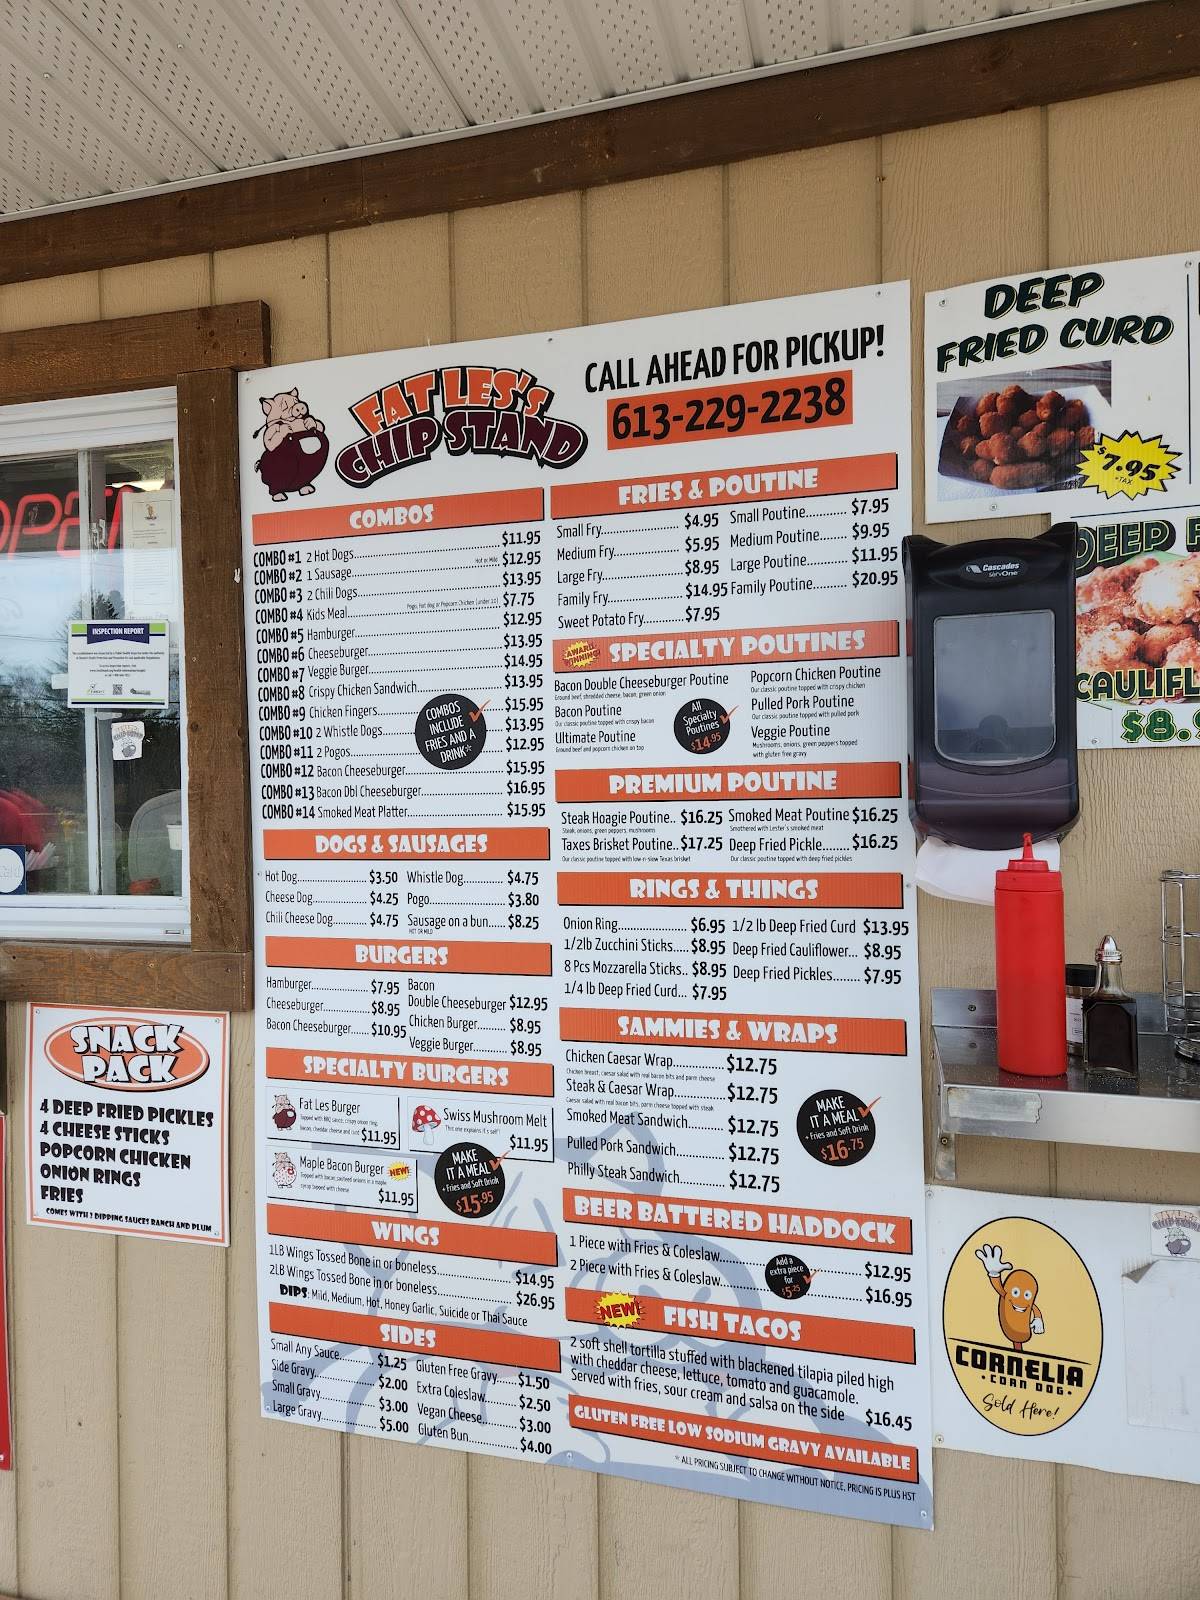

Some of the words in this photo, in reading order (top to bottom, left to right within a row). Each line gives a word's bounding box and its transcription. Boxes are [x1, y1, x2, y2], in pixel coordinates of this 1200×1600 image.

[984, 272, 1104, 319] DEEP
[937, 323, 1048, 372] FRIED
[1060, 314, 1174, 348] CURD
[585, 360, 640, 393] CALL
[647, 346, 726, 388] AHEAD
[732, 341, 778, 373] FOR
[785, 325, 884, 367] PICKUP!
[349, 370, 437, 436] FAT
[612, 377, 848, 440] 613-229-2238
[336, 419, 443, 489] CHIP
[440, 414, 588, 469] STAND
[1098, 446, 1160, 480] $7.95
[619, 481, 683, 506] FRIES
[688, 479, 703, 500] &
[709, 468, 818, 498] POUTINE
[349, 504, 435, 529] COMBOS
[557, 525, 584, 539] Small
[685, 513, 719, 529] $4.95
[315, 550, 329, 562] Hot
[502, 531, 541, 547] $11.95
[983, 563, 1019, 572] Cascades
[731, 582, 766, 598] Family
[852, 571, 898, 588] $20.95
[610, 637, 734, 663] SPECIALTY
[742, 630, 865, 657] POUTINES
[309, 685, 335, 699] Crispy
[338, 684, 371, 697] Chicken
[505, 674, 543, 689] $13.95
[751, 670, 792, 685] Popcorn
[795, 667, 836, 681] Chicken
[840, 666, 881, 678] Poutine
[426, 700, 461, 720] COMBOS
[683, 710, 717, 728] Specialty
[692, 701, 702, 713] All
[429, 716, 464, 735] INCLUDE
[686, 720, 720, 737] Poutines
[425, 736, 448, 752] FRIES
[450, 731, 467, 747] AND
[469, 728, 476, 740] A
[691, 732, 721, 751] $14.95
[609, 773, 722, 795] PREMIUM
[728, 771, 837, 792] POUTINE
[729, 808, 772, 822] Smoked
[775, 808, 803, 821] Meat
[806, 807, 849, 821] Poutine
[853, 807, 898, 823] $16.25
[316, 835, 367, 854] DOGS
[374, 836, 383, 853] &
[389, 834, 487, 852] SAUSAGES
[407, 871, 443, 884] Whistle
[508, 871, 539, 886] $4.75
[630, 879, 699, 899] RINGS
[705, 880, 720, 899] &
[726, 880, 818, 901] THINGS
[768, 918, 797, 934] Deep
[800, 919, 827, 933] Fried
[830, 919, 856, 933] Curd
[864, 919, 909, 936] $13.95
[356, 944, 448, 966] BURGERS
[70, 1024, 184, 1054] SNACK
[618, 1017, 721, 1041] SAMMIES
[727, 1020, 741, 1042] &
[748, 1021, 838, 1045] WRAPS
[81, 1053, 178, 1084] PACK
[304, 1056, 407, 1081] SPECIALTY
[412, 1064, 508, 1087] BURGERS
[566, 1049, 604, 1065] Chicken
[607, 1052, 641, 1066] Caesar
[727, 1055, 777, 1074] $12.75
[40, 1099, 48, 1114] 4
[53, 1099, 93, 1116] DEEP
[97, 1103, 143, 1121] FRIED
[148, 1107, 213, 1127] PICKLES
[300, 1098, 312, 1110] Fat
[314, 1099, 329, 1112] Les
[332, 1100, 360, 1116] Burger
[444, 1109, 470, 1122] Swiss
[473, 1110, 524, 1127] Mushroom
[526, 1113, 547, 1128] Melt
[40, 1121, 48, 1136] 4
[53, 1121, 110, 1140] CHEESE
[115, 1126, 170, 1145] STICKS
[362, 1129, 396, 1145] $11.95
[40, 1142, 115, 1162] POPCORN
[120, 1149, 191, 1169] CHICKEN
[452, 1149, 477, 1164] MAKE
[40, 1164, 90, 1182] ONION
[93, 1169, 140, 1187] RINGS
[446, 1167, 456, 1180] IT
[458, 1166, 465, 1178] A
[466, 1163, 490, 1178] MEAL
[41, 1185, 84, 1203] FRIES
[456, 1191, 493, 1214] $15.95
[46, 1208, 67, 1216] COMES
[69, 1210, 88, 1218] WITH
[95, 1213, 123, 1222] DIPPING
[125, 1216, 149, 1224] SAUCES
[151, 1219, 174, 1227] RANCH
[192, 1224, 211, 1232] PLUM
[574, 1196, 632, 1219] BEER
[638, 1202, 762, 1233] BATTERED
[768, 1213, 896, 1245] HADDOCK
[371, 1222, 439, 1246] WINGS
[516, 1271, 554, 1288] $14.95
[664, 1306, 718, 1331] FISH
[724, 1313, 801, 1341] TACOS
[380, 1324, 436, 1348] SIDES
[416, 1360, 446, 1378] Gluten
[449, 1364, 468, 1380] Free
[518, 1372, 549, 1389] $1.50
[956, 1345, 1083, 1388] CORNELIA
[990, 1375, 1027, 1389] CORN
[1036, 1383, 1064, 1395] DOG
[982, 1393, 1014, 1412] Sold
[1020, 1400, 1060, 1420] Here!
[866, 1410, 912, 1431] $16.45
[574, 1405, 628, 1424] GLUTEN
[631, 1412, 665, 1431] FREE
[668, 1419, 702, 1438] LOW
[706, 1426, 764, 1448] SODIUM
[768, 1436, 820, 1457] GRAVY
[825, 1445, 910, 1471] AVAILABLE
[682, 1456, 693, 1465] ALL
[694, 1458, 718, 1469] PRICING
[720, 1462, 747, 1474] SUBJECT
[749, 1467, 757, 1476] TO
[759, 1469, 785, 1481] CHANGE
[786, 1474, 818, 1486] WITHOUT
[820, 1479, 845, 1491] NOTICE,
[848, 1483, 873, 1495] PRICING
[876, 1488, 881, 1496] IS
[884, 1489, 900, 1499] PLUS
[903, 1492, 916, 1501] HST
